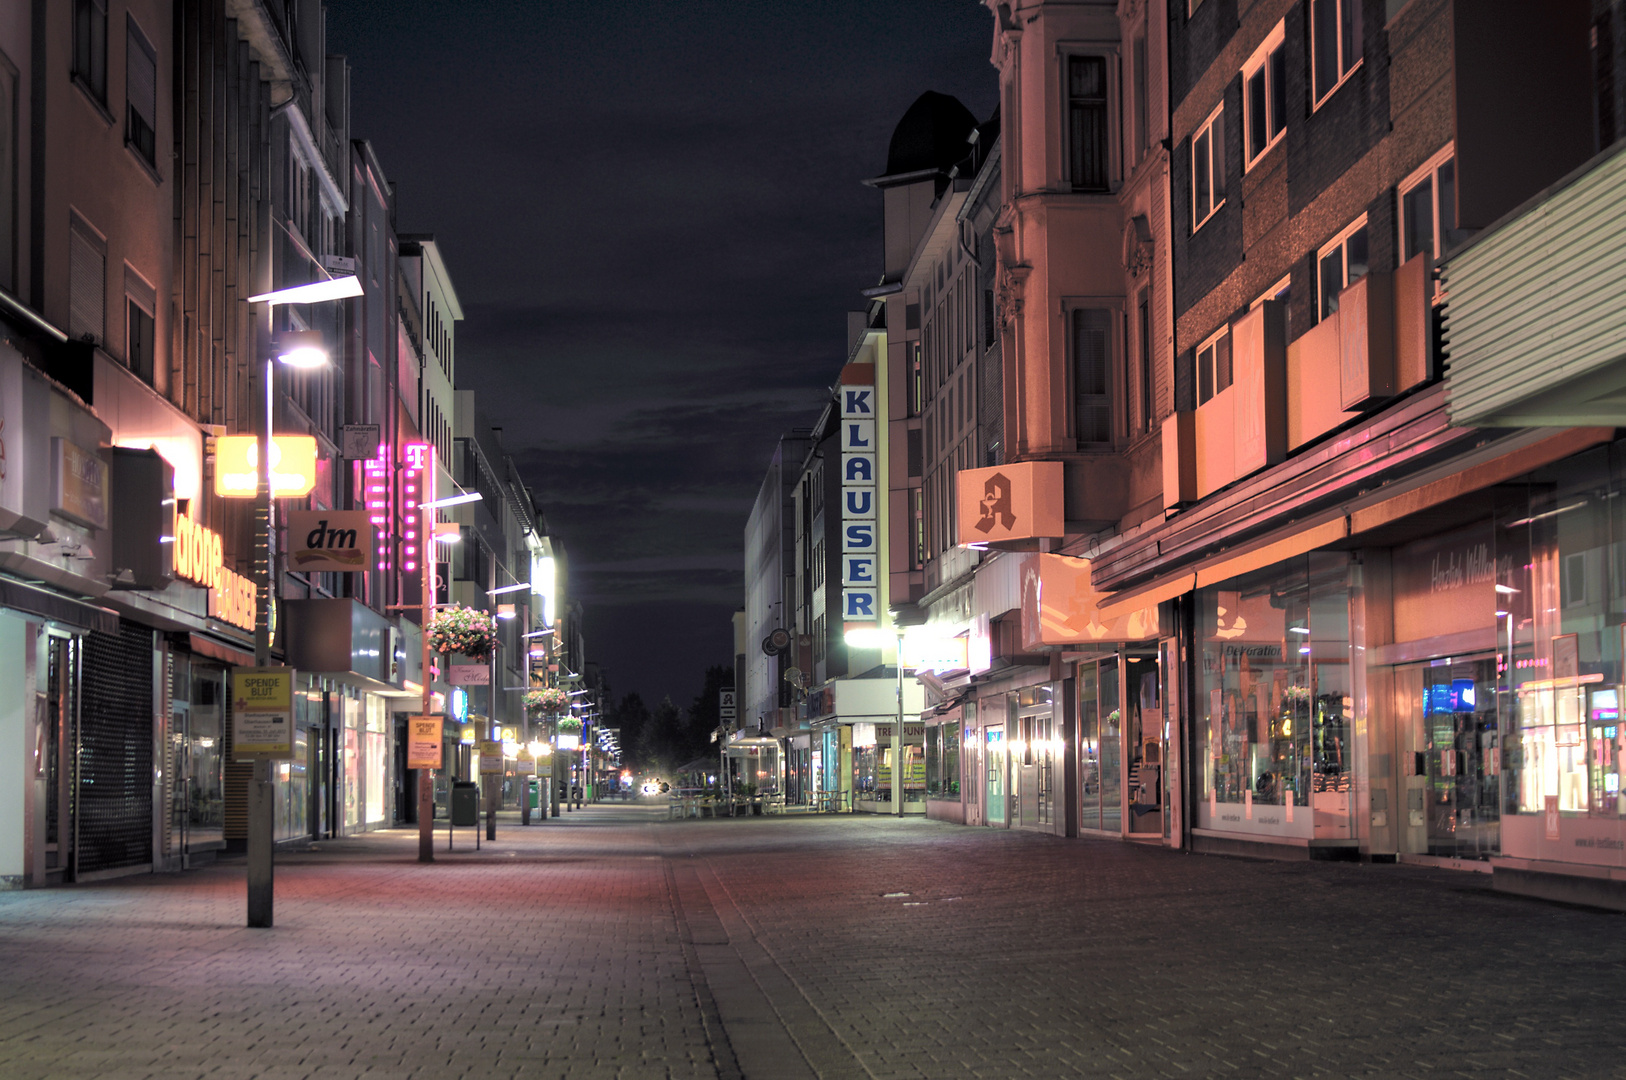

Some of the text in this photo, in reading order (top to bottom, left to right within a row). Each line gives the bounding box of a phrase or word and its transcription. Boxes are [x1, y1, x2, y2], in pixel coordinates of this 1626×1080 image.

[845, 390, 875, 616] KLAUSER
[306, 520, 357, 549] dm
[1226, 645, 1281, 656] Dekoration
[244, 678, 280, 688] SPENDE
[251, 687, 273, 697] BLUT
